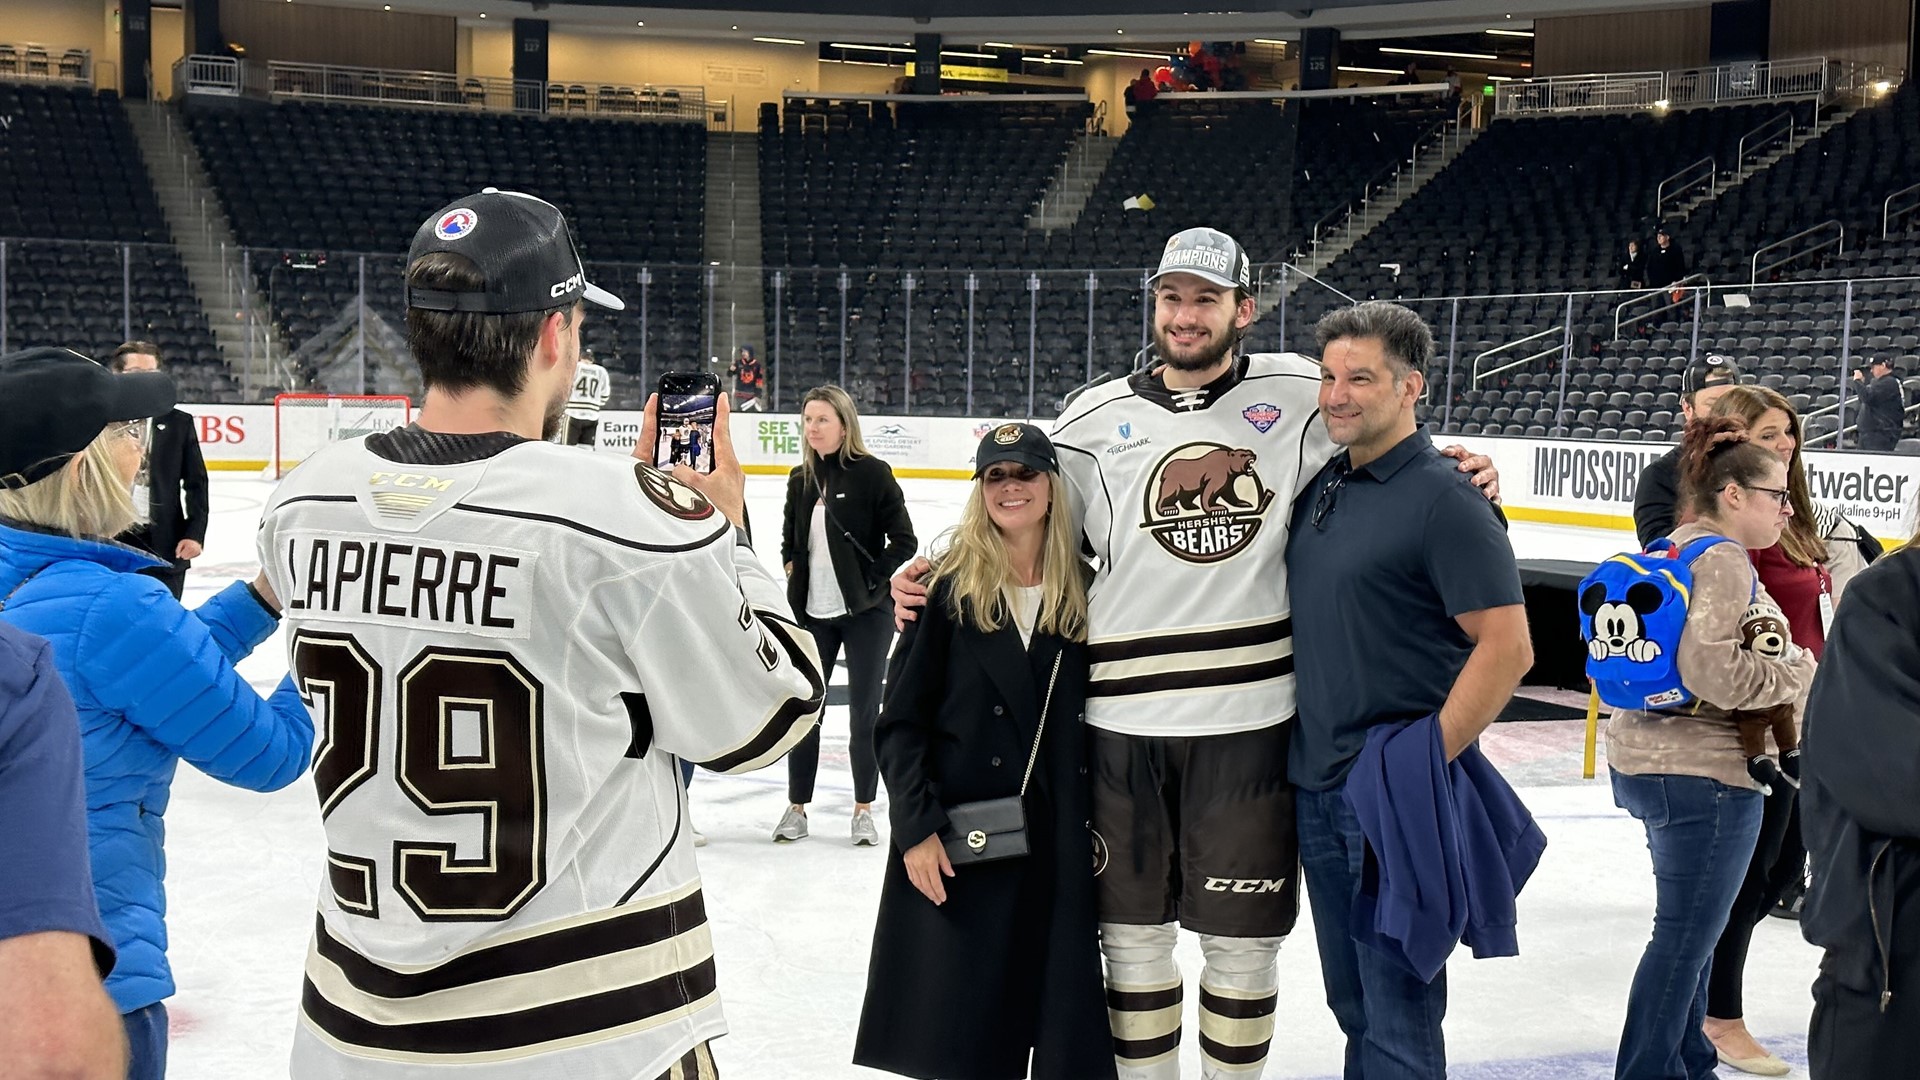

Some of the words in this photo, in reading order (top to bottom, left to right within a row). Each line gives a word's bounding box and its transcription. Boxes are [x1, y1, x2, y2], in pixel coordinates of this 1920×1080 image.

[1310, 62, 1325, 70] 125
[1163, 249, 1229, 273] CHAMPIONS
[551, 272, 582, 298] CCM
[576, 376, 599, 398] 40
[603, 421, 639, 433] Earn
[758, 421, 789, 435] SEE
[603, 436, 638, 447] with
[758, 436, 800, 454] THE
[370, 472, 455, 492] CCM
[1178, 516, 1234, 530] HERSHEY
[1872, 506, 1901, 522] 9+pH
[1170, 524, 1244, 554] BEARS
[289, 538, 520, 629] LAPIERRE
[292, 628, 547, 923] 29
[1204, 876, 1286, 893] CCM
